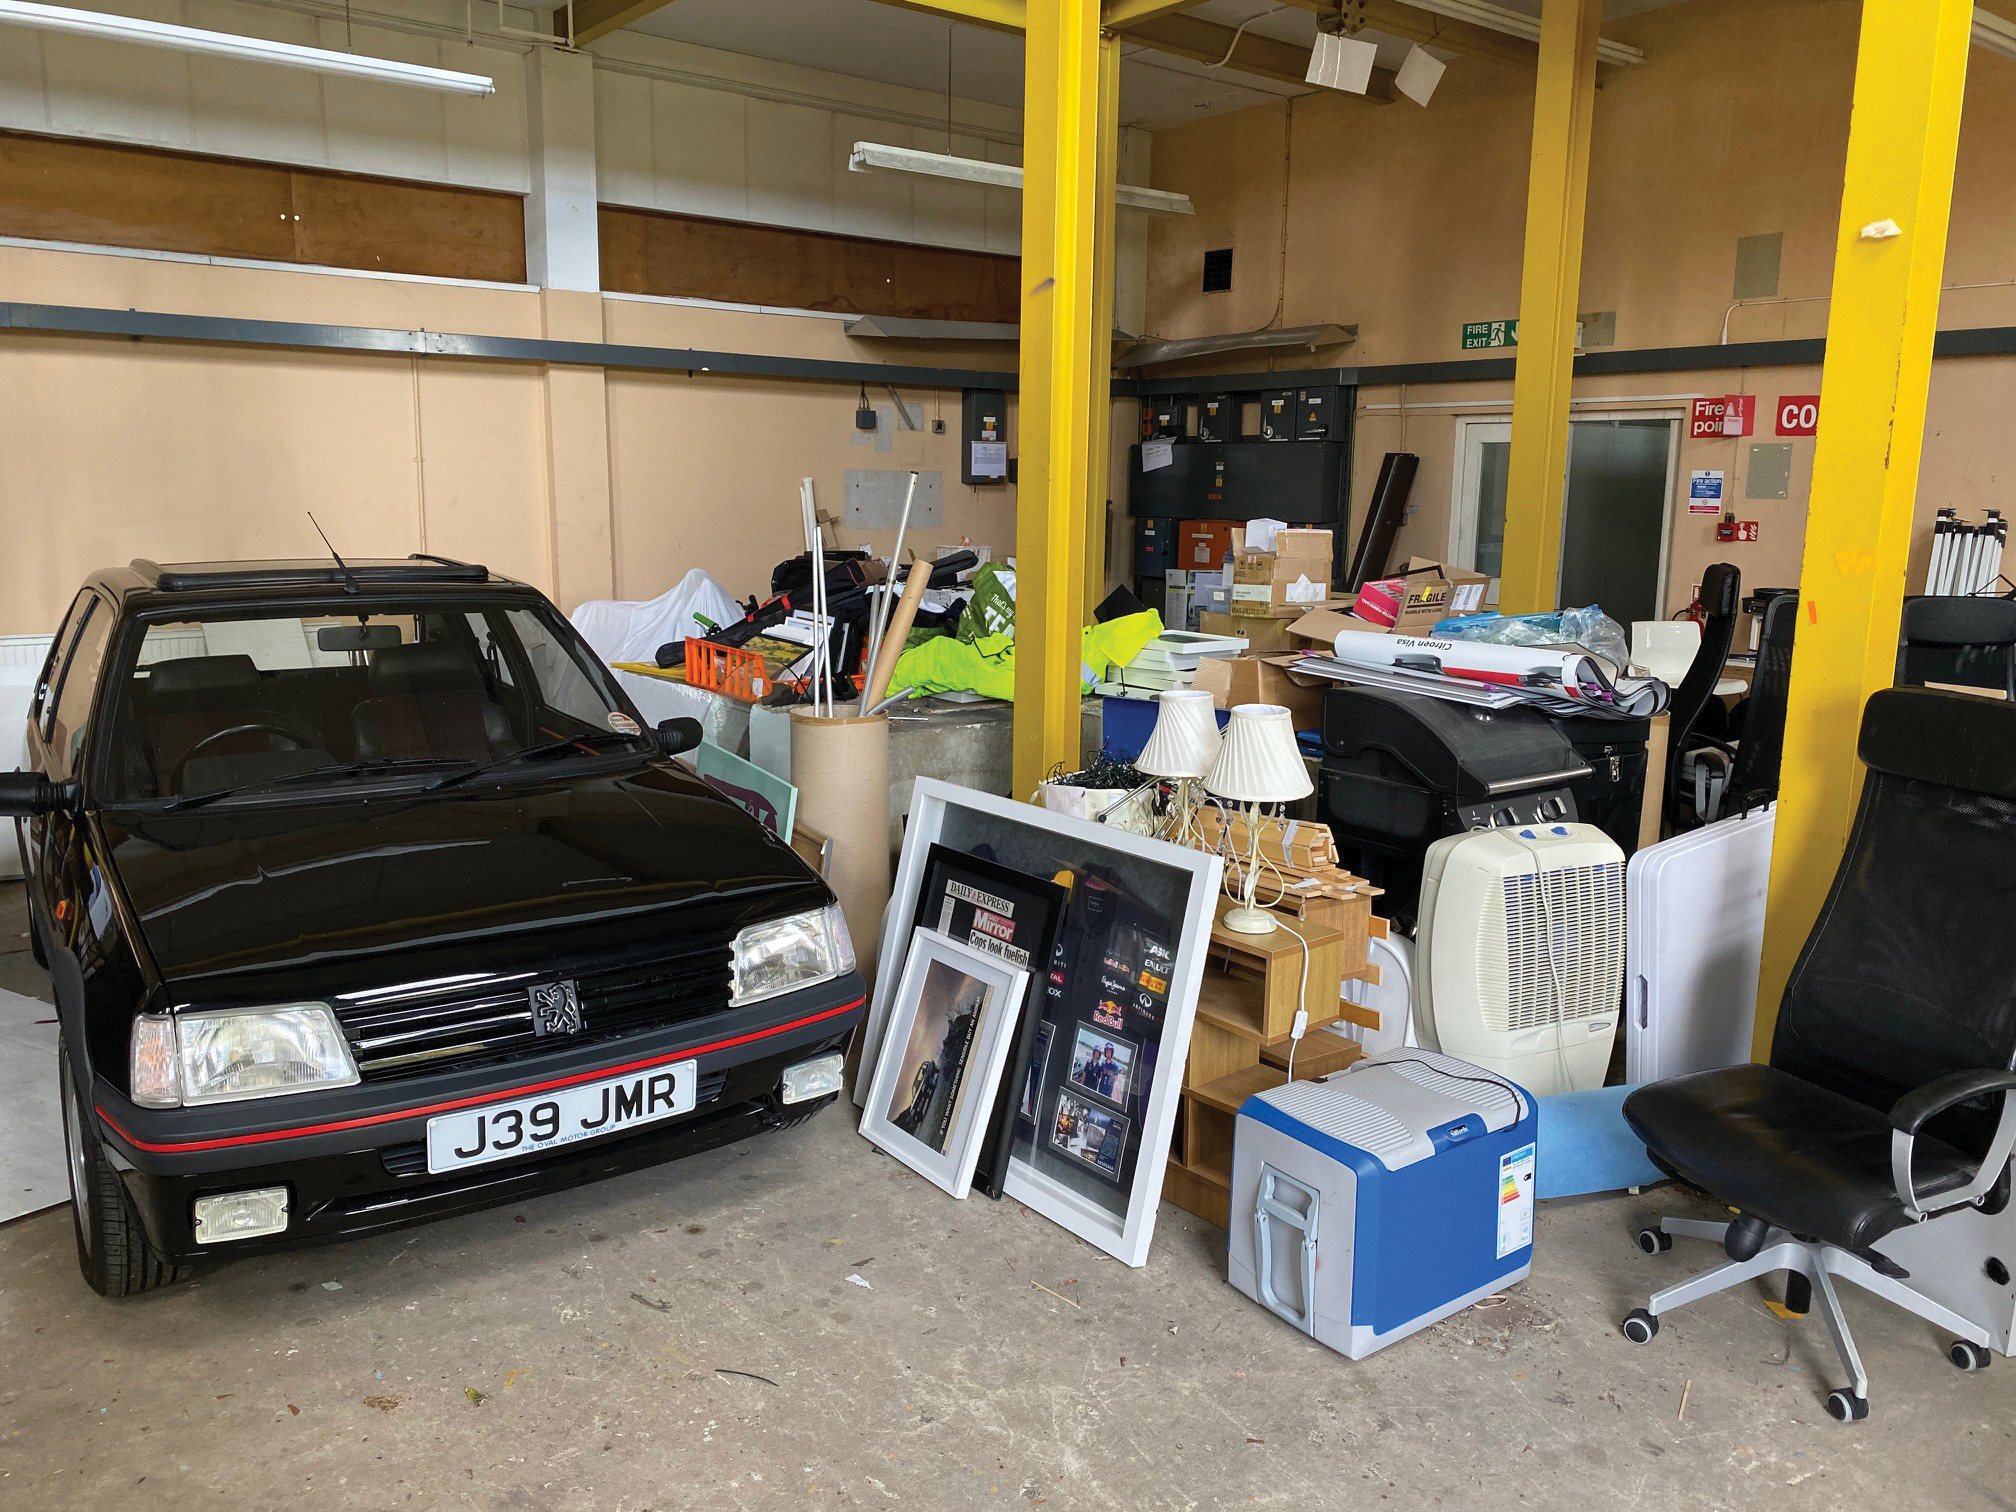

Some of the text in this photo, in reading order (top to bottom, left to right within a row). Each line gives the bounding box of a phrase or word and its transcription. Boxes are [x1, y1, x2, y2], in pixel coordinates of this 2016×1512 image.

[1467, 324, 1488, 335] FIRE
[1466, 338, 1487, 348] EXIT
[1694, 401, 1724, 416] Fire
[1396, 638, 1453, 651] Citroen Visa
[950, 881, 1010, 913] DAILY EXPRESS
[973, 909, 1013, 939] Mirror
[969, 931, 1028, 966] Cops look fuelish
[972, 996, 982, 1018] ANORAK
[970, 1018, 976, 1028] AN
[958, 1040, 969, 1066] SENSIBLE
[950, 1068, 962, 1101] SOMETHING
[454, 1073, 676, 1159] J39 JMR
[944, 1098, 952, 1116] WANT
[521, 1124, 617, 1153] THE OVAL MOTOR GROUP
